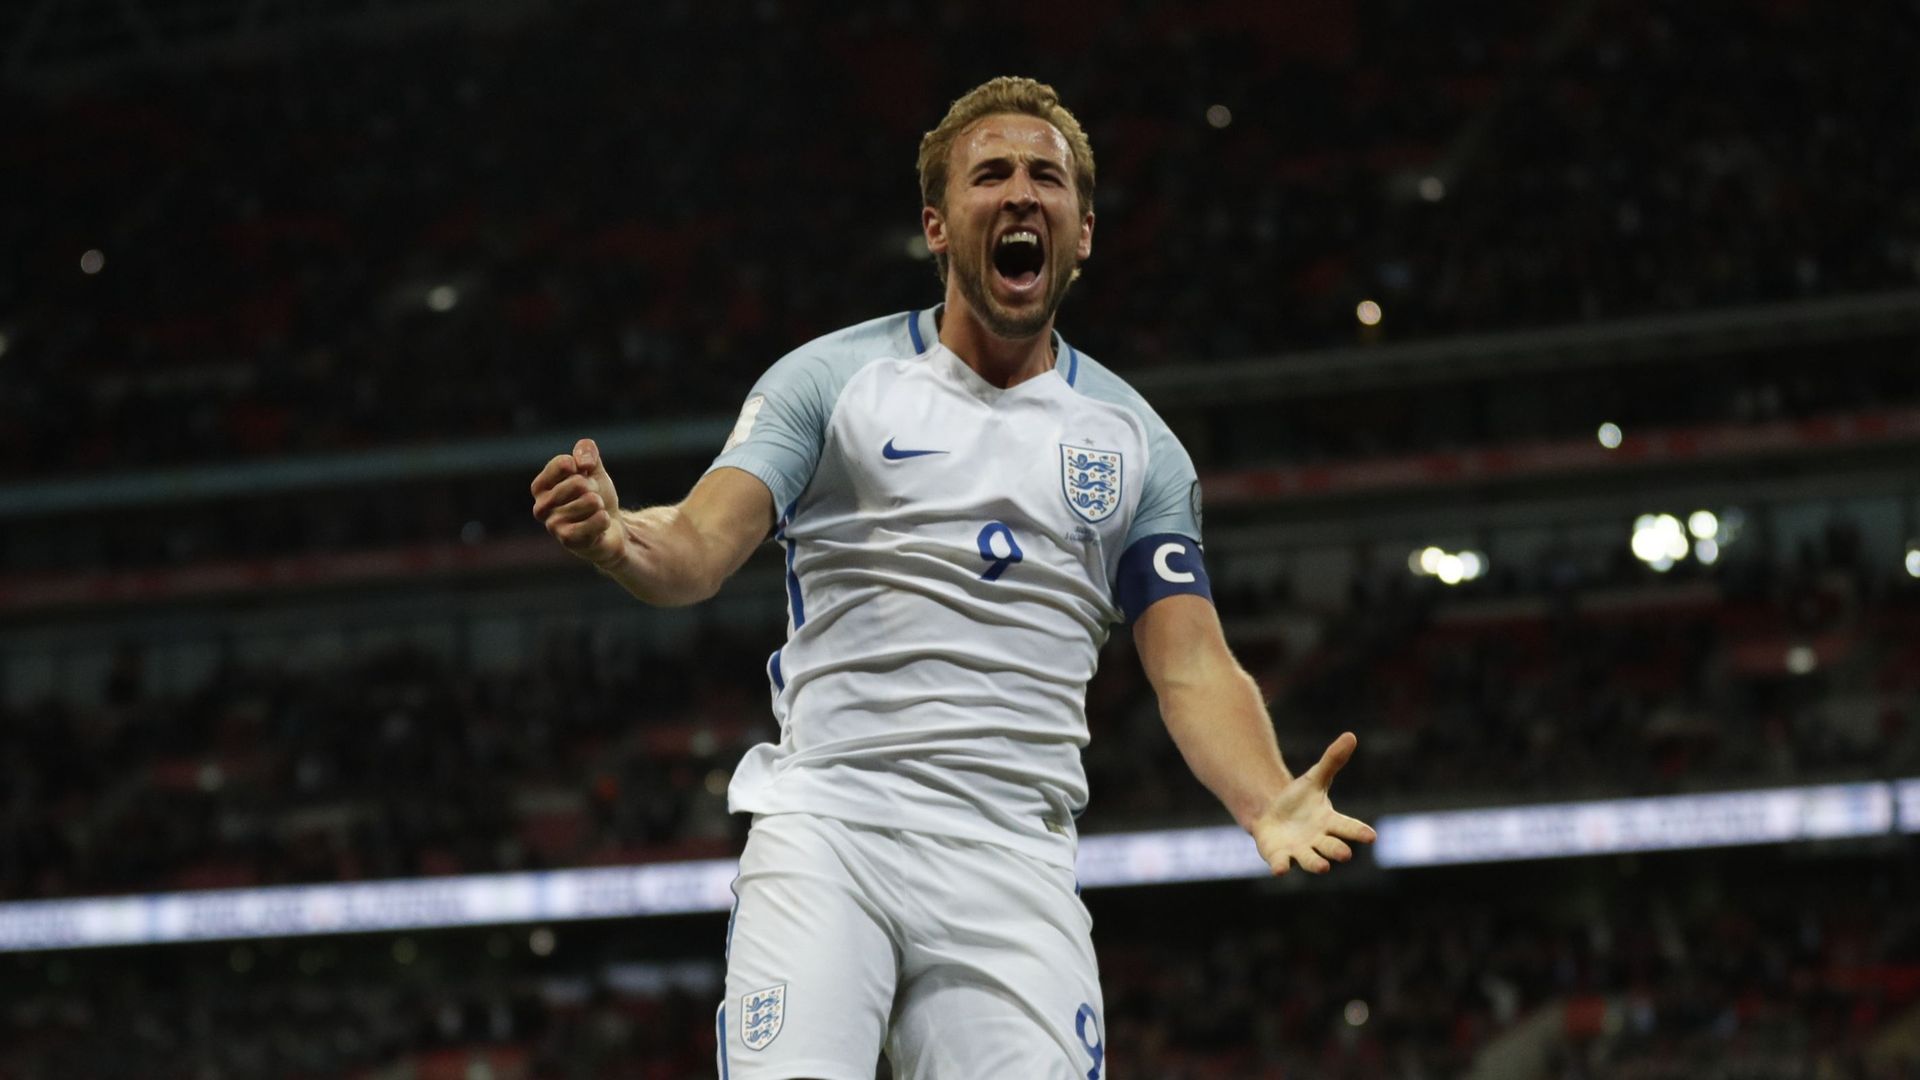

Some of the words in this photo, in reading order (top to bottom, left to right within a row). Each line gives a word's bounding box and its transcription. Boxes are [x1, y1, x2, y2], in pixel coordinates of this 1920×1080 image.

[977, 522, 1023, 582] 9
[1152, 542, 1196, 583] C
[1075, 1003, 1104, 1080] 9
